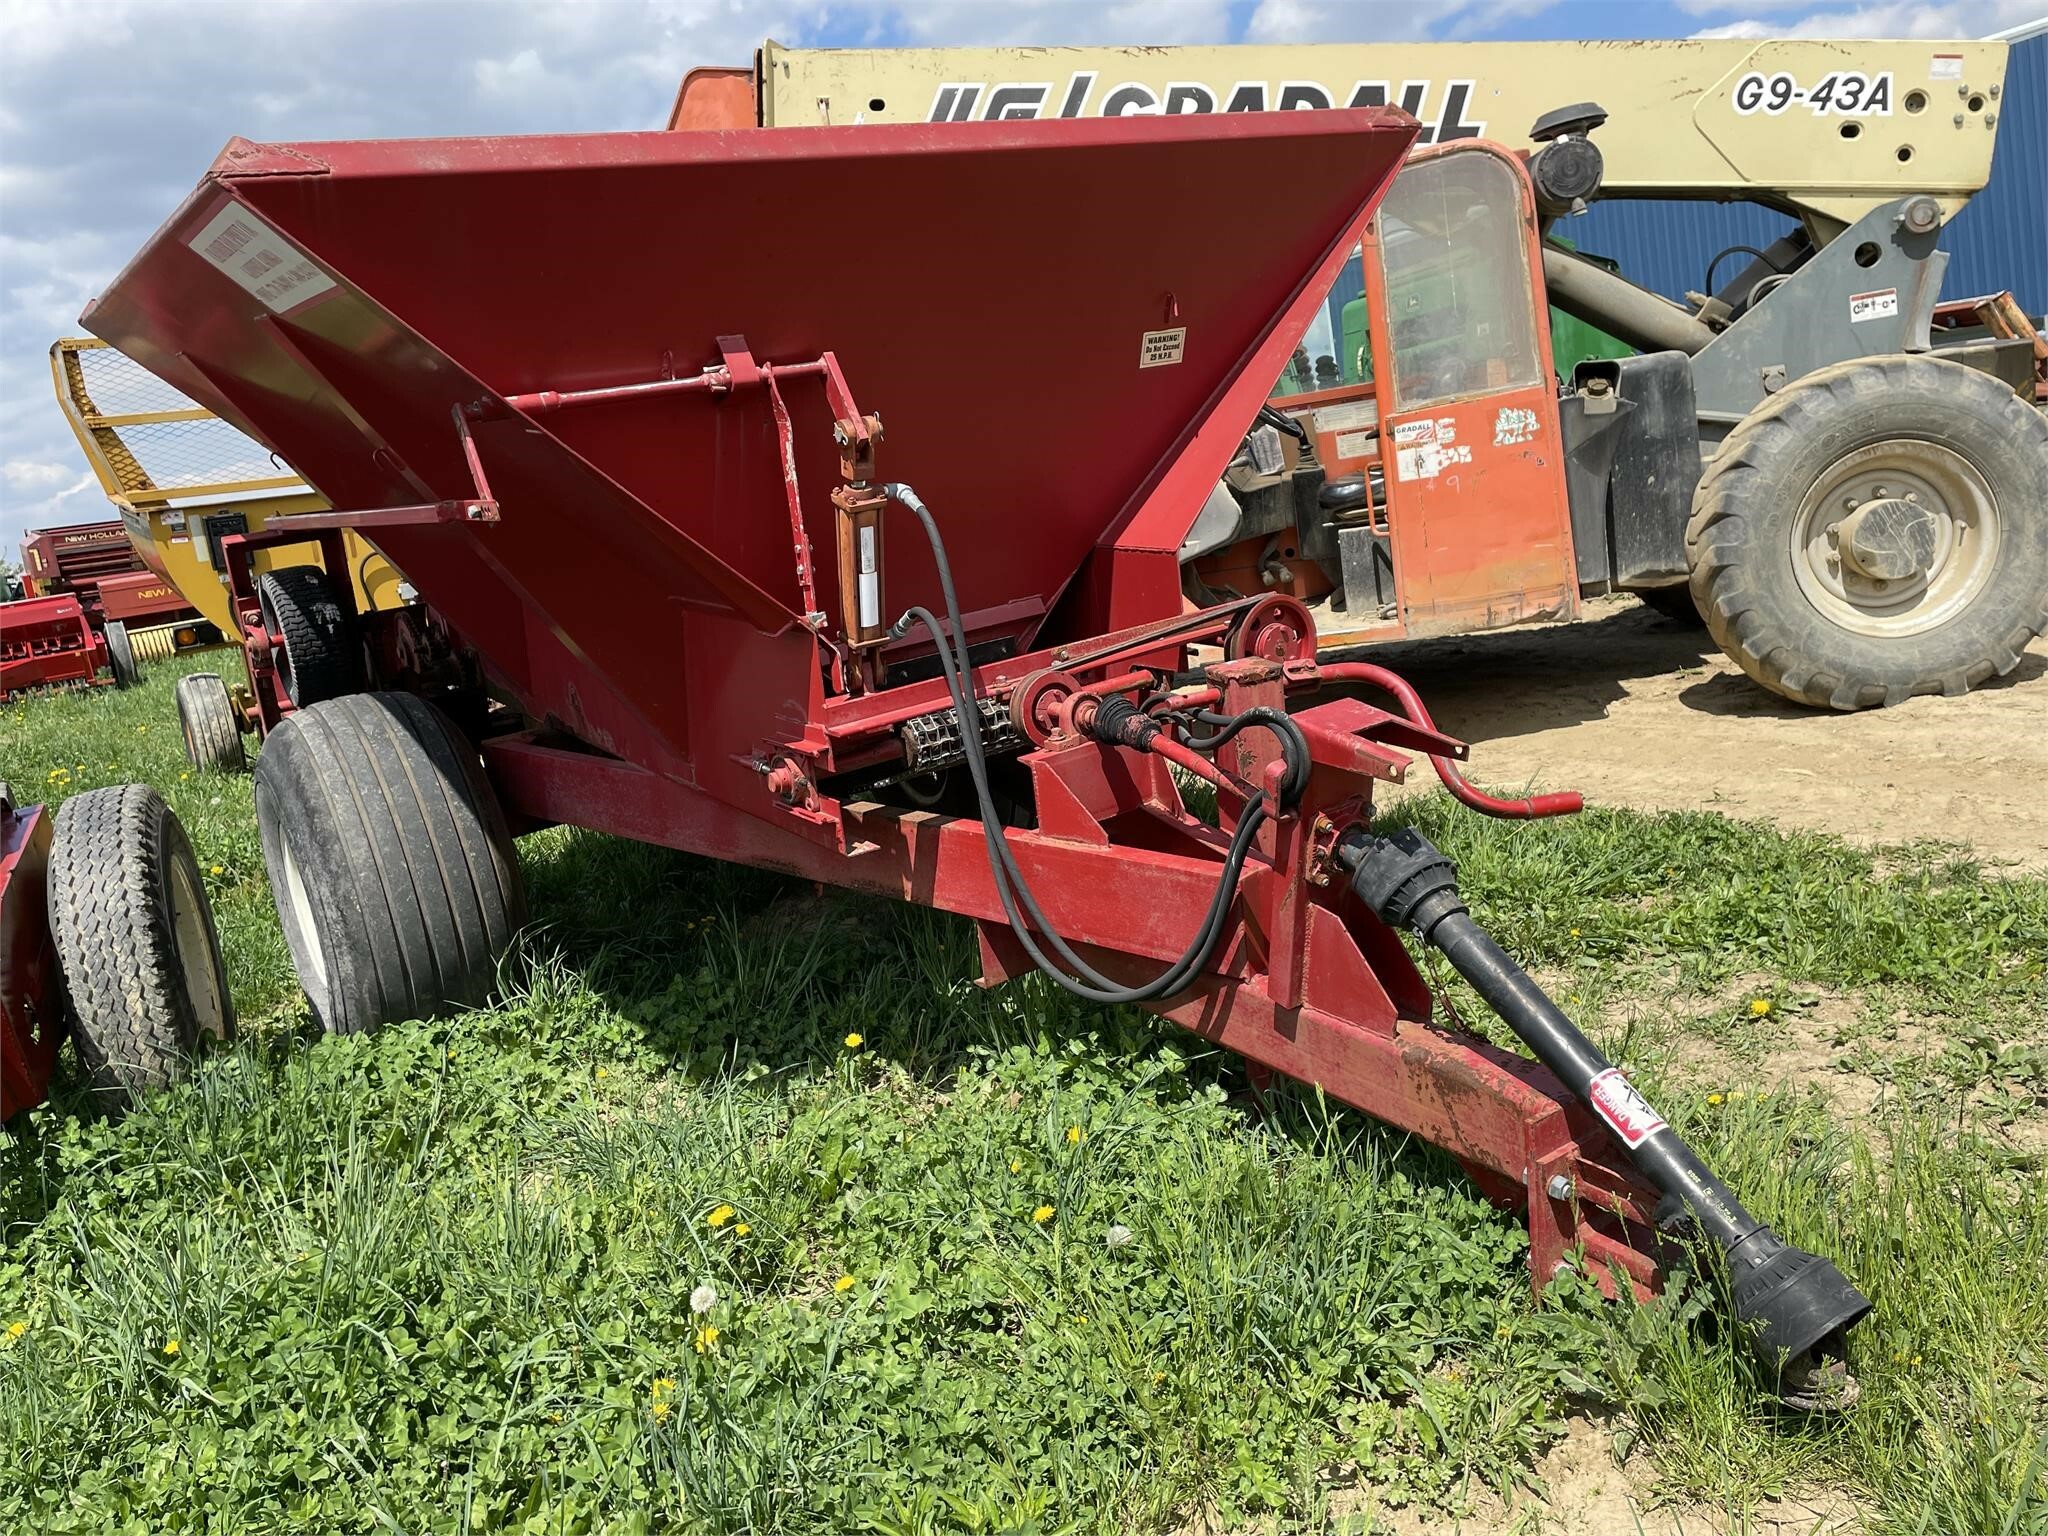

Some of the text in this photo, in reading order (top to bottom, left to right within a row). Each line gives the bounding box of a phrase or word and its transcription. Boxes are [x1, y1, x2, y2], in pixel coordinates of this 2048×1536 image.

[1737, 76, 1889, 111] G9-43A
[1148, 334, 1180, 344] WARNING!
[1396, 423, 1431, 434] GRADALL
[65, 529, 128, 543] NEW HOLLAN
[137, 588, 165, 599] NEW
[1595, 1087, 1627, 1122] DANGER
